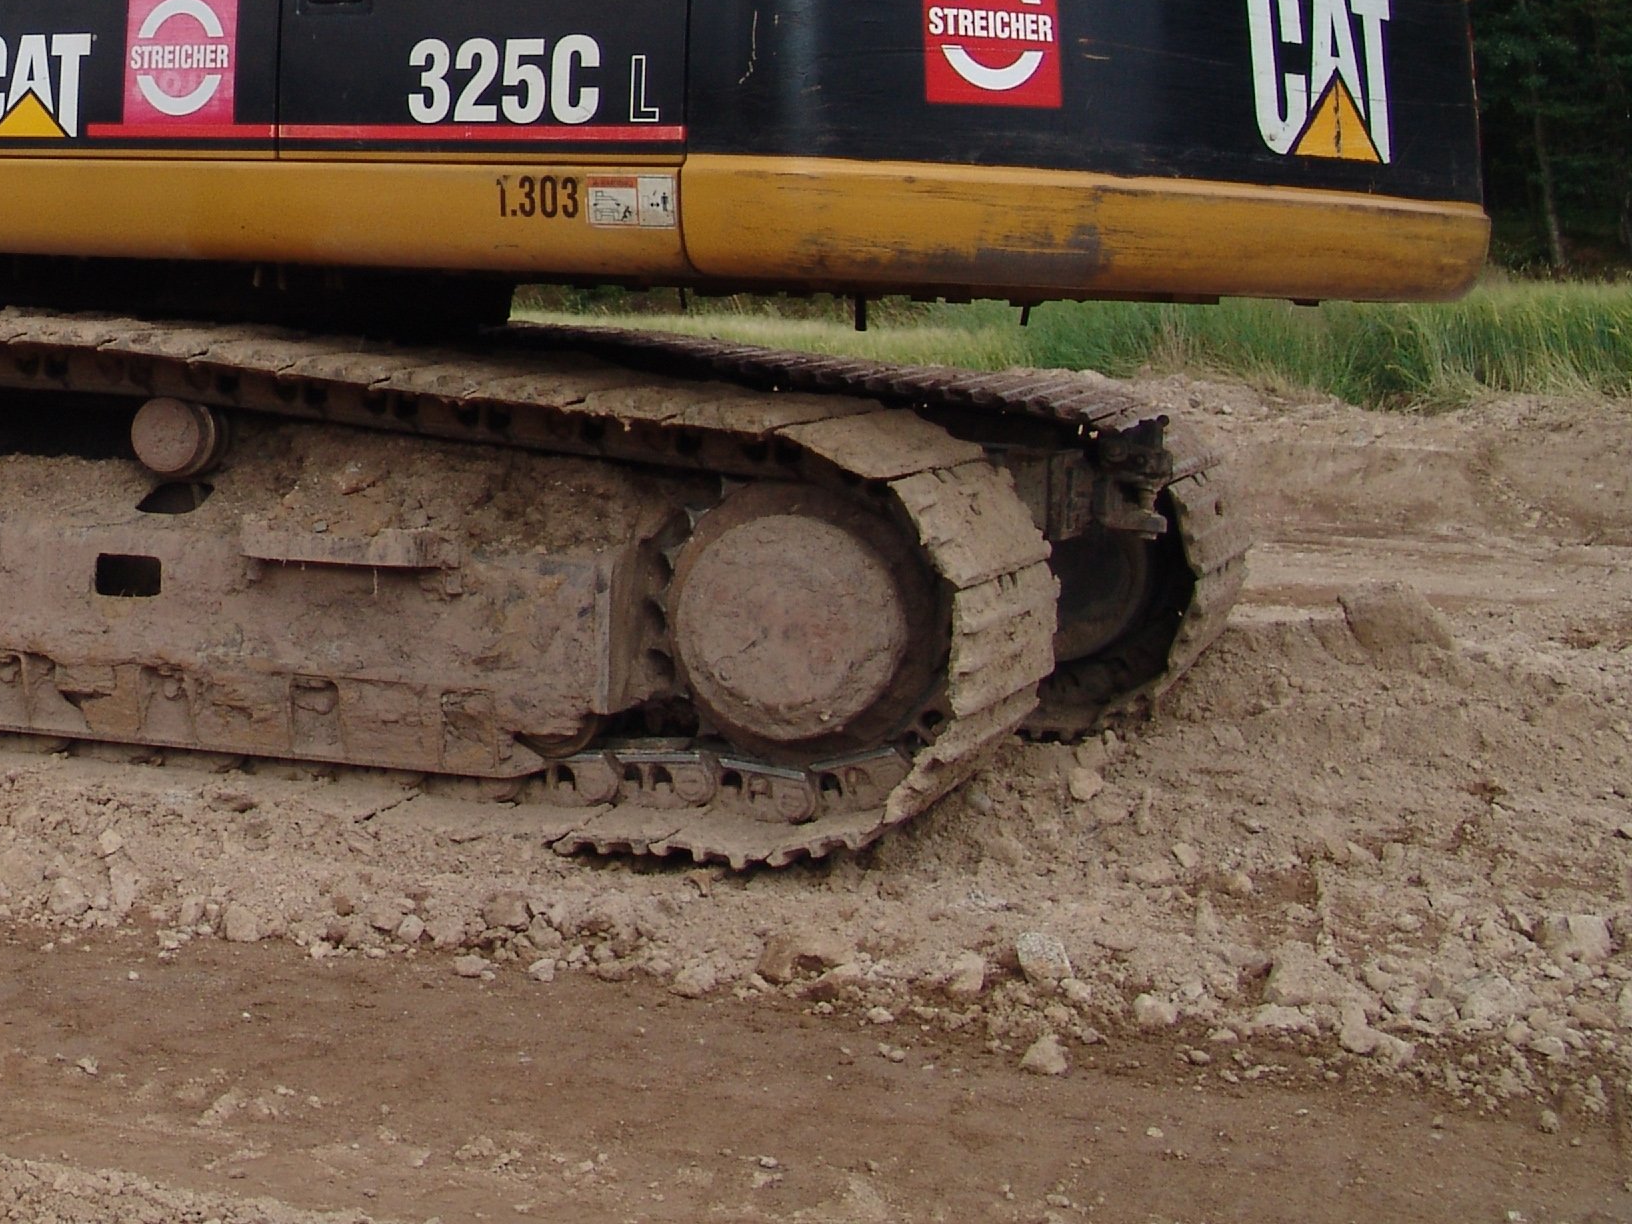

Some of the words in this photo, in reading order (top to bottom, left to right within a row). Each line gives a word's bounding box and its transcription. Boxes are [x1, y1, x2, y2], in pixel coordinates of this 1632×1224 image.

[928, 6, 1053, 43] STREICHER
[130, 44, 228, 69] STREICHER
[408, 34, 601, 124] 325C
[630, 54, 660, 123] L
[495, 175, 579, 218] 1.303
